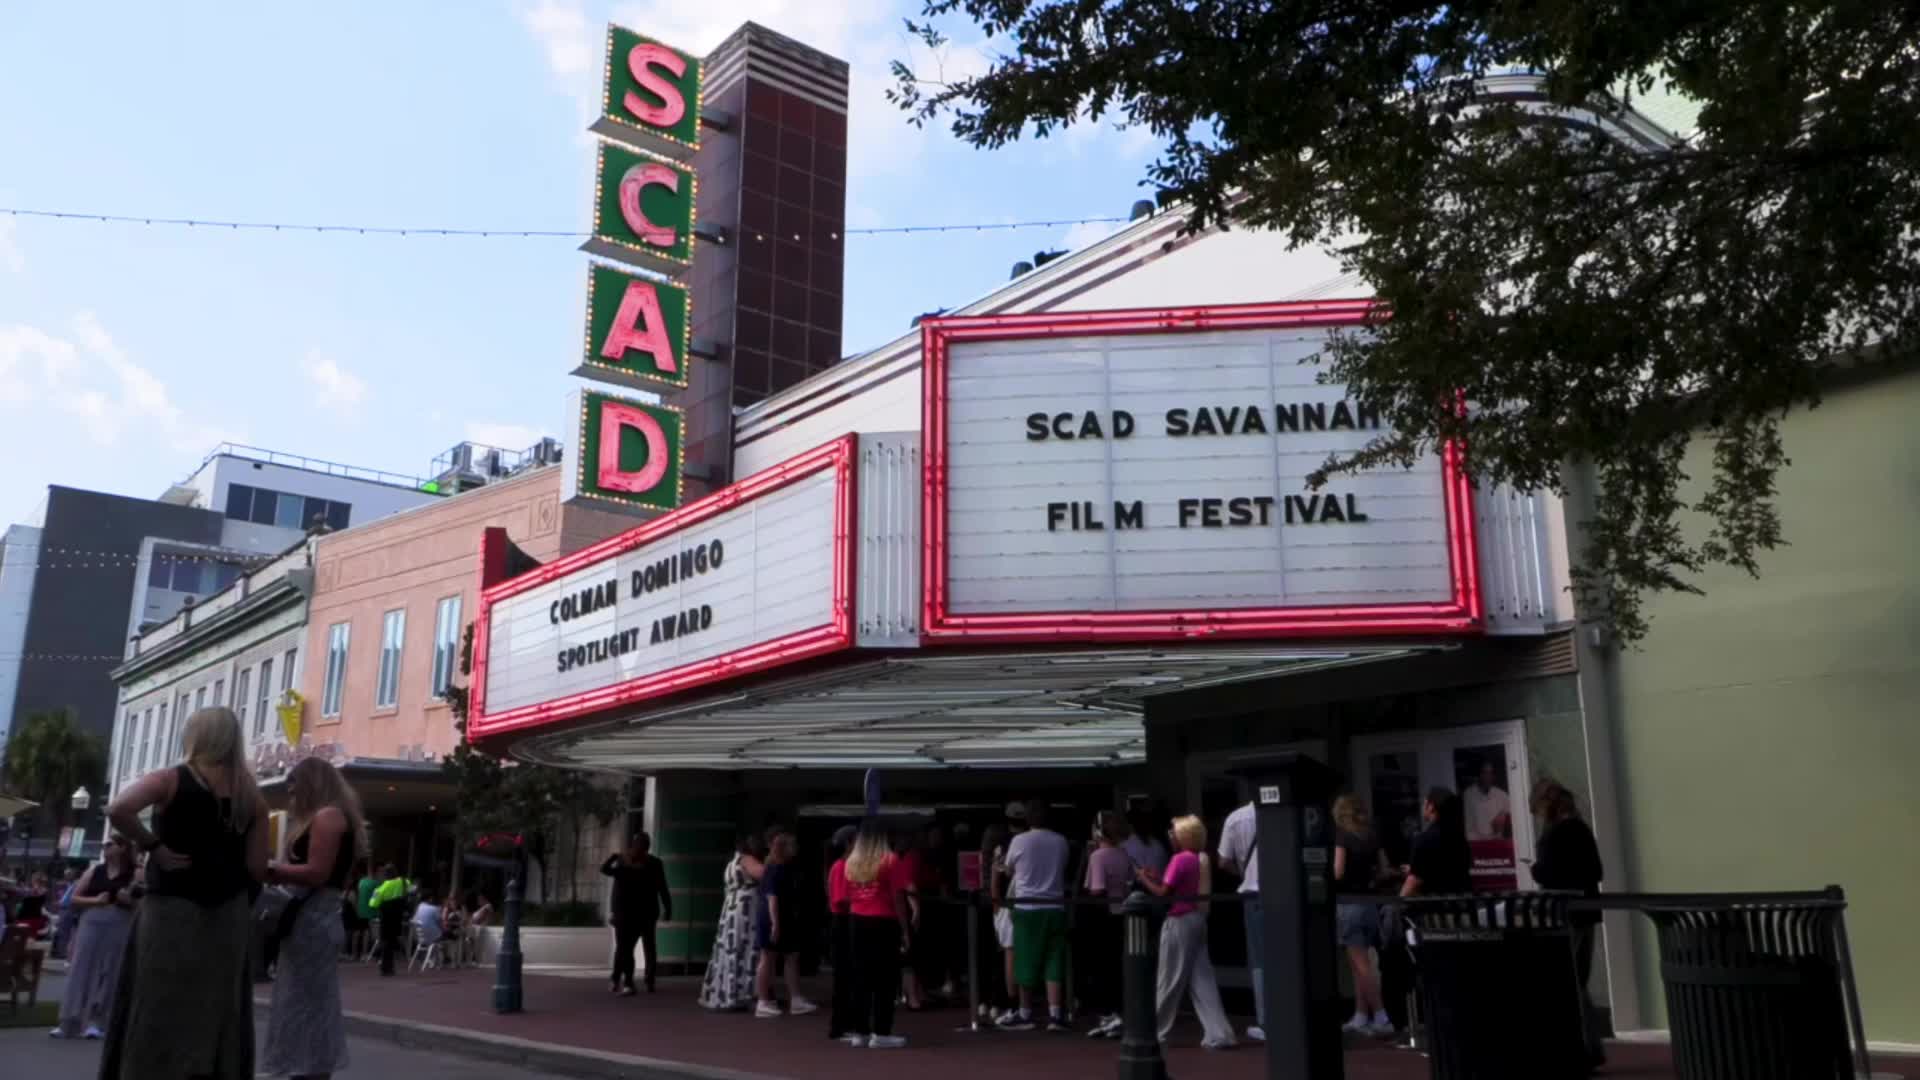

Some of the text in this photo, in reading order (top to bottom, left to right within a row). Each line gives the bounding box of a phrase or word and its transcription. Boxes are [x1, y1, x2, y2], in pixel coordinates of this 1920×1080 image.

[596, 41, 688, 494] SCAD
[1026, 400, 1379, 441] SCAD SAVANNAH
[1047, 493, 1368, 531] FILM FESTIVAL
[549, 538, 724, 625] COLMAN DOMINGO
[557, 604, 713, 673] SPOTLIGHT AWARD
